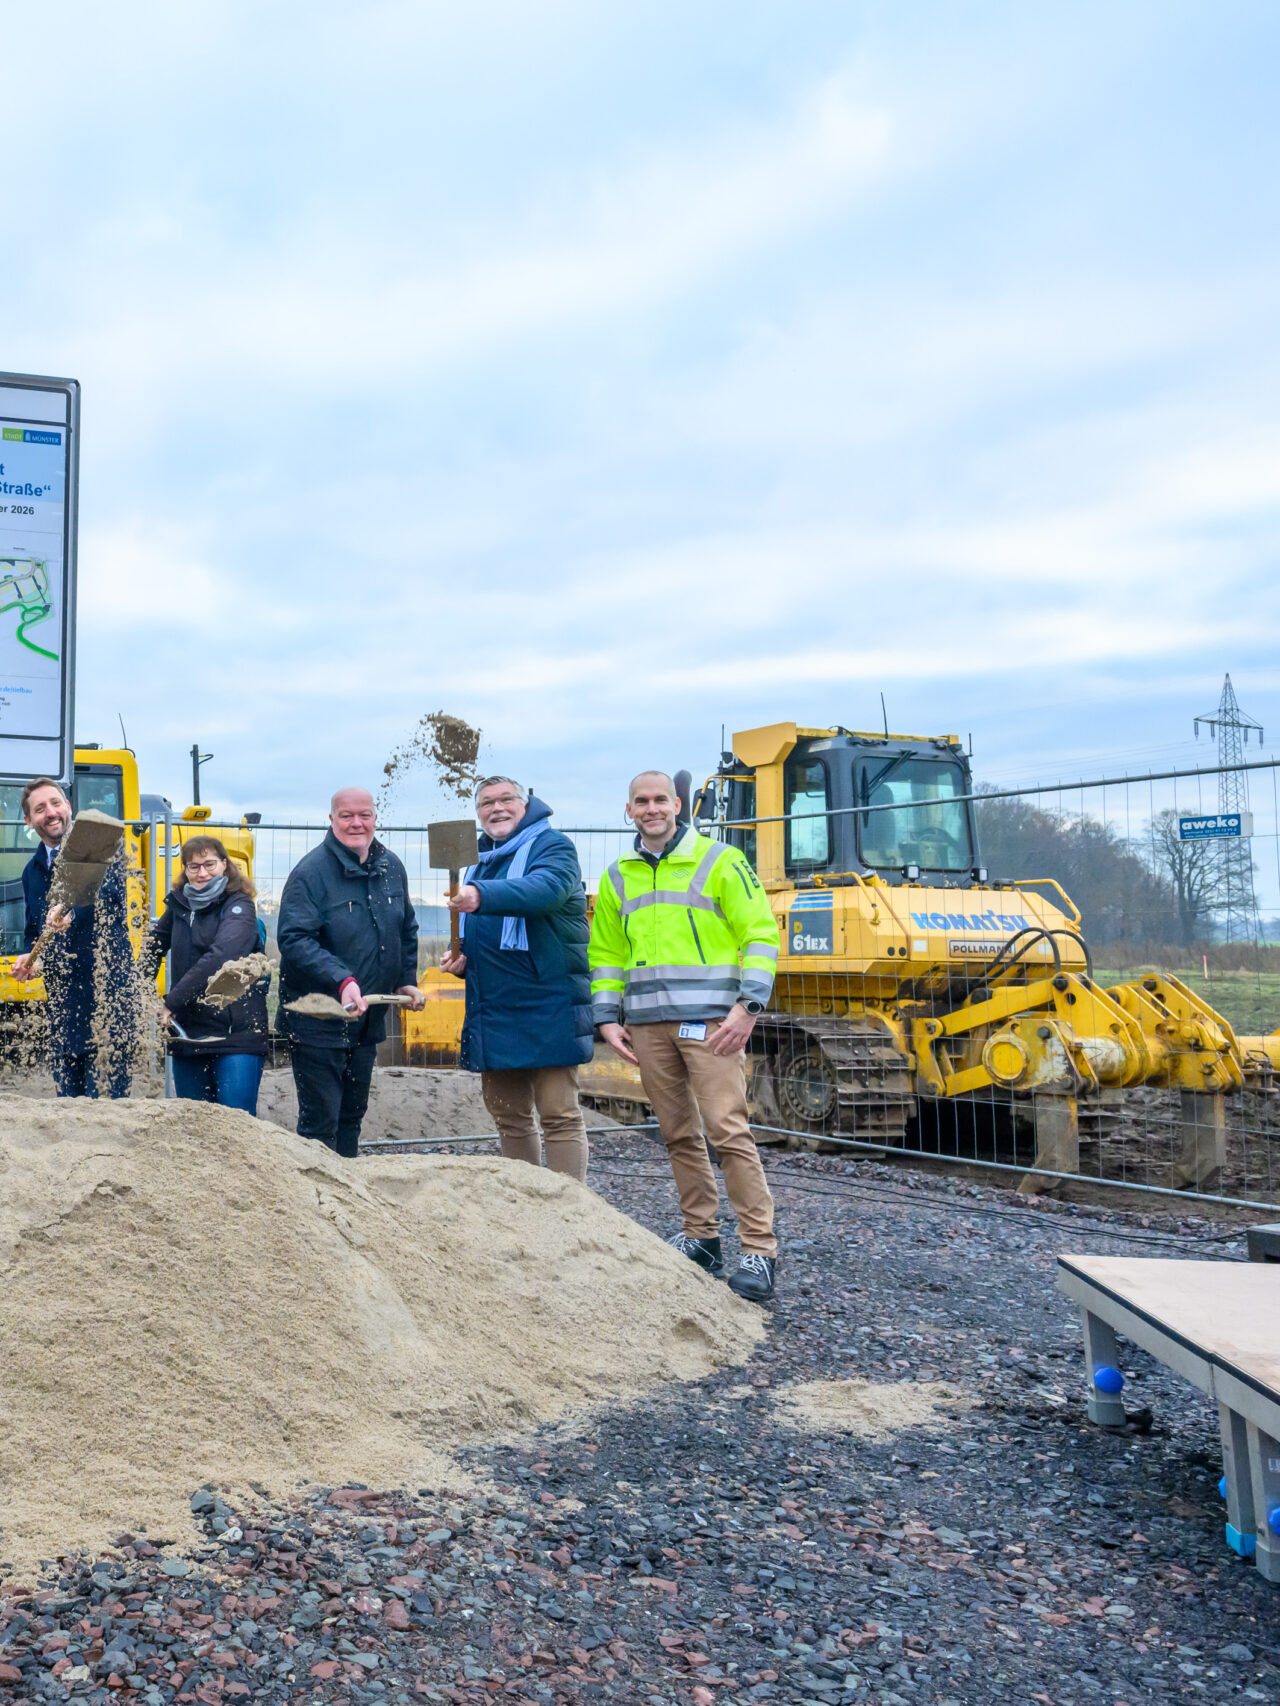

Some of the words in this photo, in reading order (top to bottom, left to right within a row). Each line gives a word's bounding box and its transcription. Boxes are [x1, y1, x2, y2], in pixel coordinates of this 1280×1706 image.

[31, 435, 59, 443] MÜNSTER
[10, 505, 35, 515] 2026
[1181, 816, 1239, 830] aweko
[909, 909, 1031, 932] KOMATSU
[793, 921, 803, 934] D
[792, 934, 829, 951] 61EX
